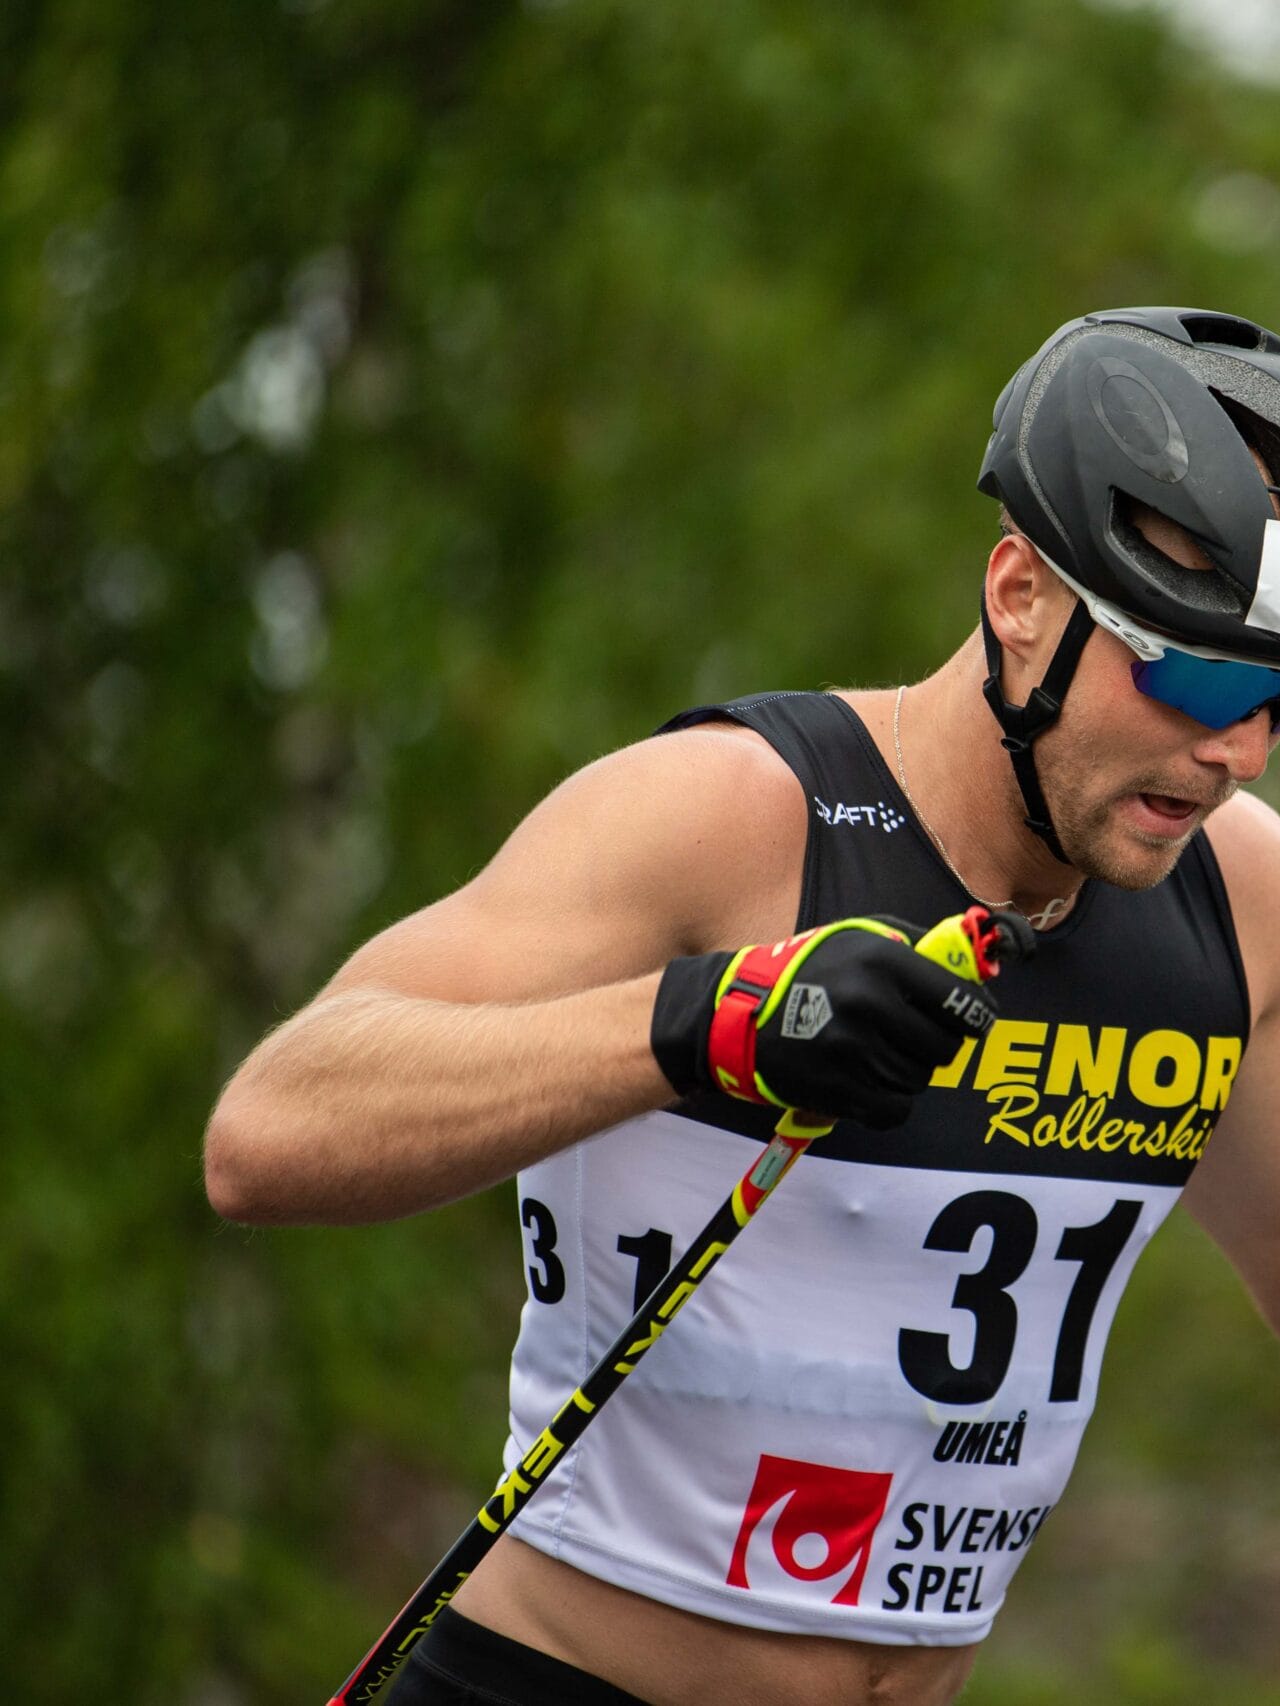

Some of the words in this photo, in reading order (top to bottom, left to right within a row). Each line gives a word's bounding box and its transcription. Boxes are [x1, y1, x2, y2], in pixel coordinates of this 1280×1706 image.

[898, 1190, 1144, 1405] 31
[477, 1387, 596, 1533] LEKI
[932, 1409, 1027, 1466] UMEÅ
[881, 1562, 983, 1614] SPEL
